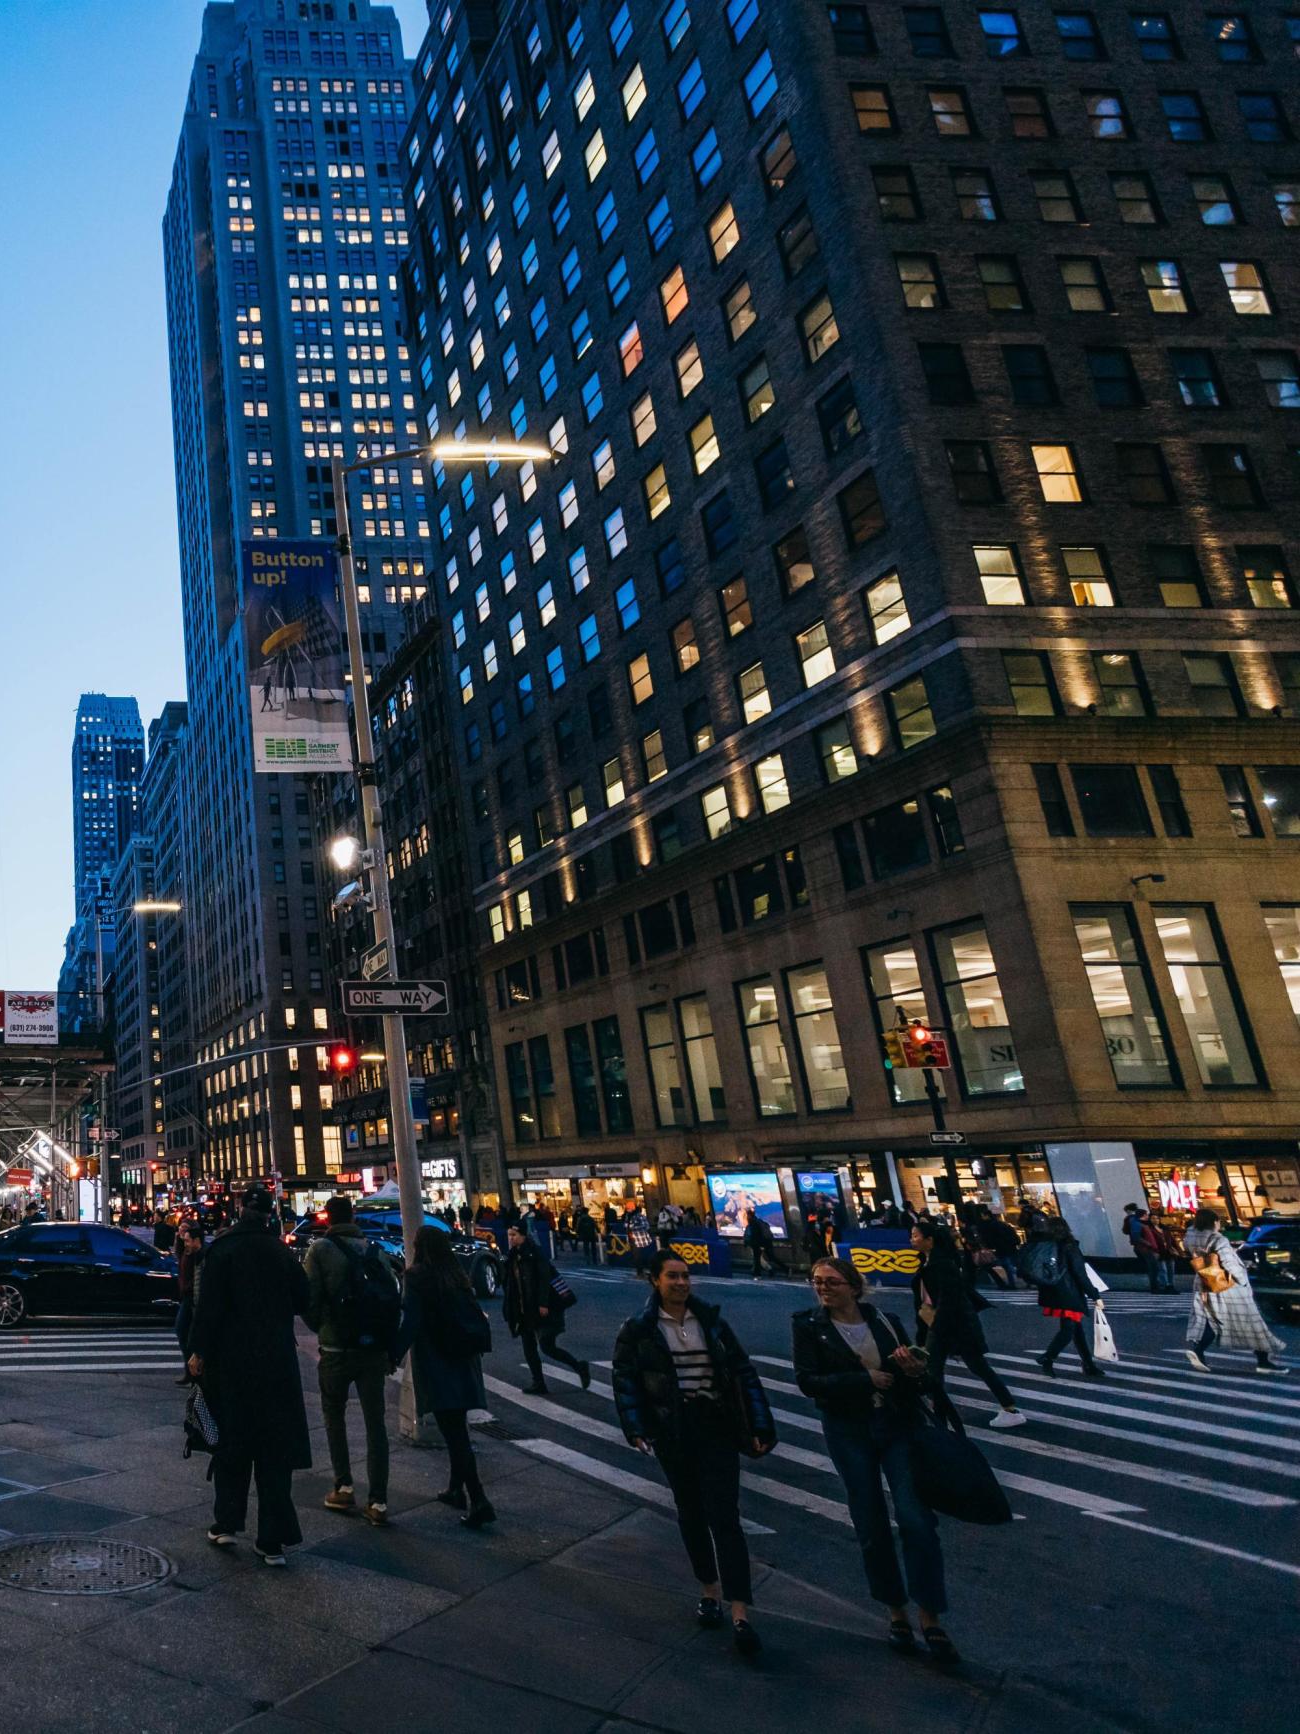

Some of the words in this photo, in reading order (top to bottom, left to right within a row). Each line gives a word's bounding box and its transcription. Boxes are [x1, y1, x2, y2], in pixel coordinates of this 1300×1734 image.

[251, 551, 324, 567] Button
[252, 570, 287, 587] up!
[353, 991, 384, 1005] ONE
[399, 991, 432, 1004] WAY
[430, 1159, 456, 1178] GIFTS
[1158, 1180, 1198, 1208] PRET
